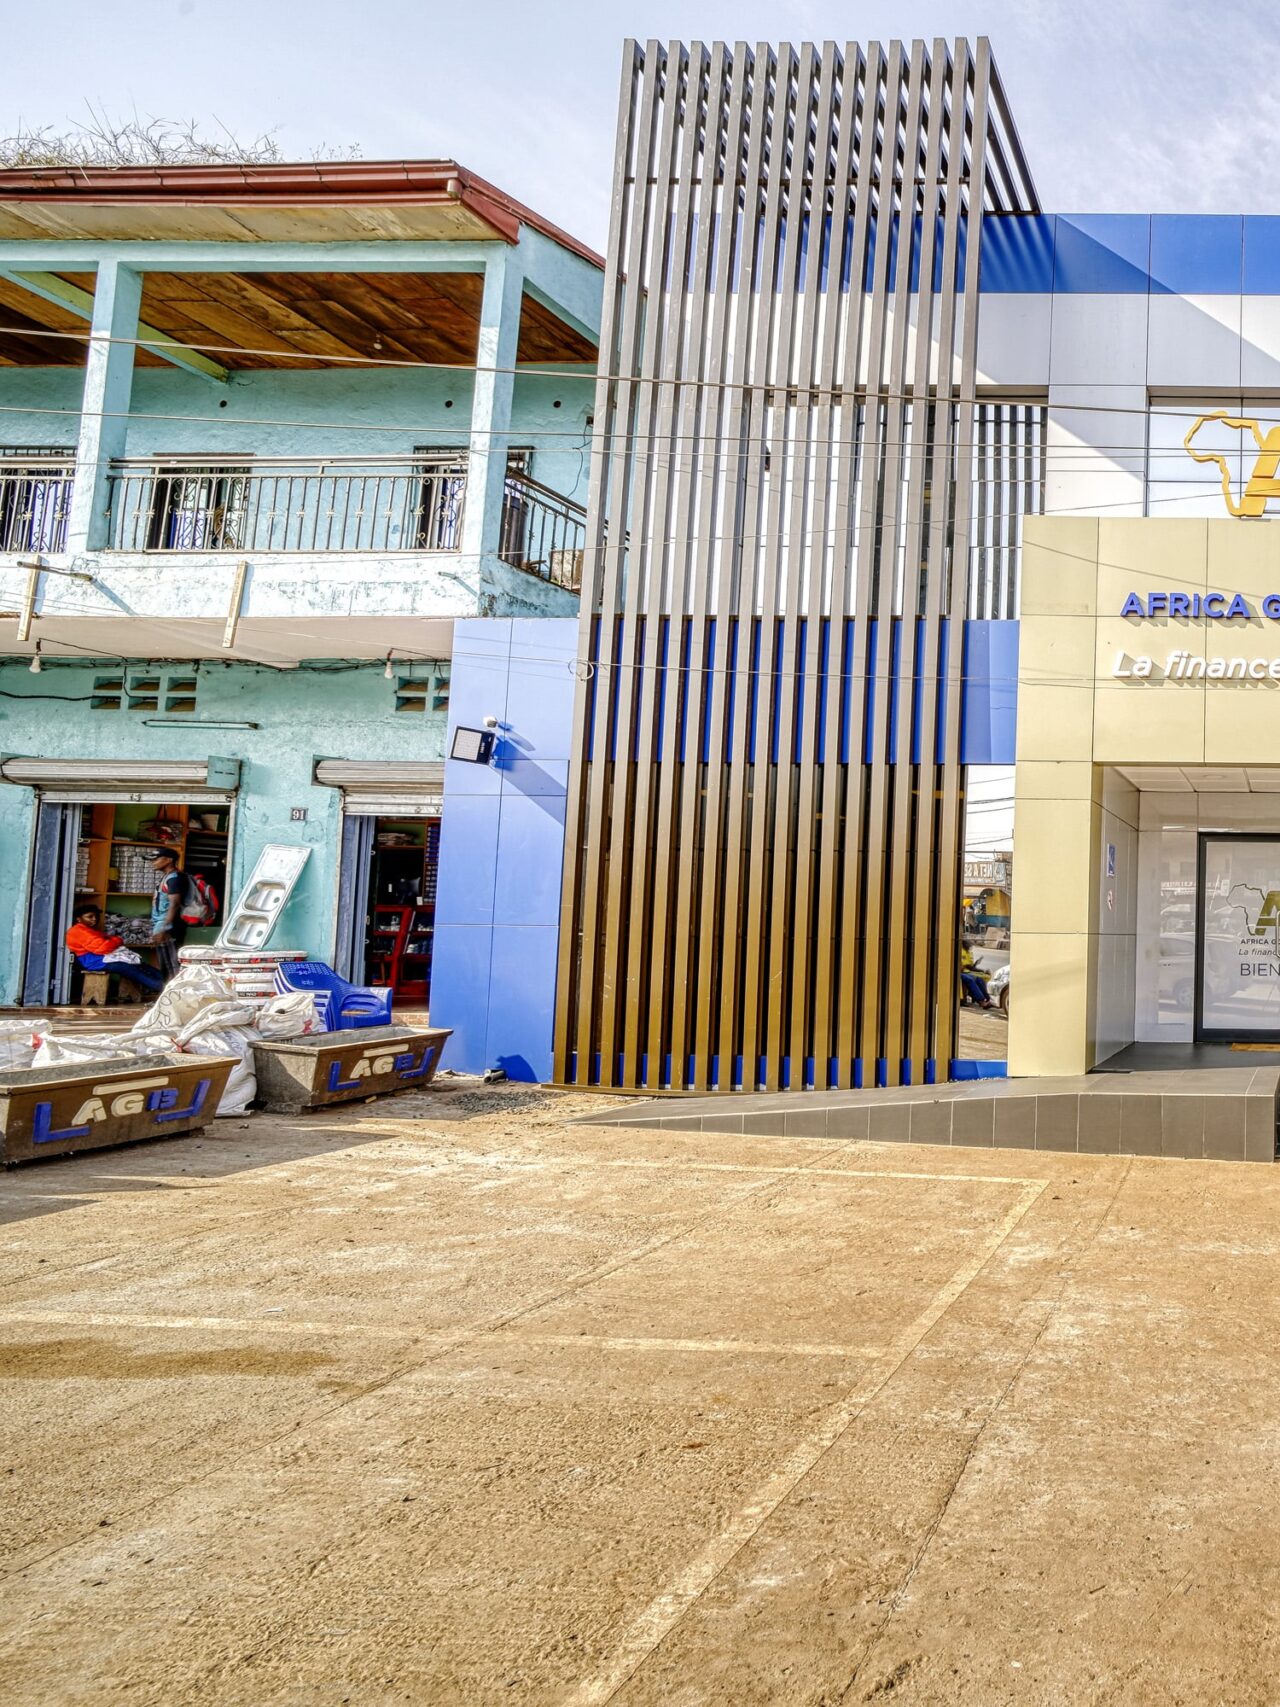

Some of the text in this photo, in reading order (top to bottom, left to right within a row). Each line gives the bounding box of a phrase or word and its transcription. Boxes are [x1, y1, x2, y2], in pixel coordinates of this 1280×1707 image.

[1120, 592, 1250, 618] AFRICA
[1112, 651, 1153, 678] La
[292, 810, 304, 820] 91
[1239, 948, 1248, 956] La
[349, 1053, 415, 1079] AGB
[71, 1087, 178, 1126] AGB
